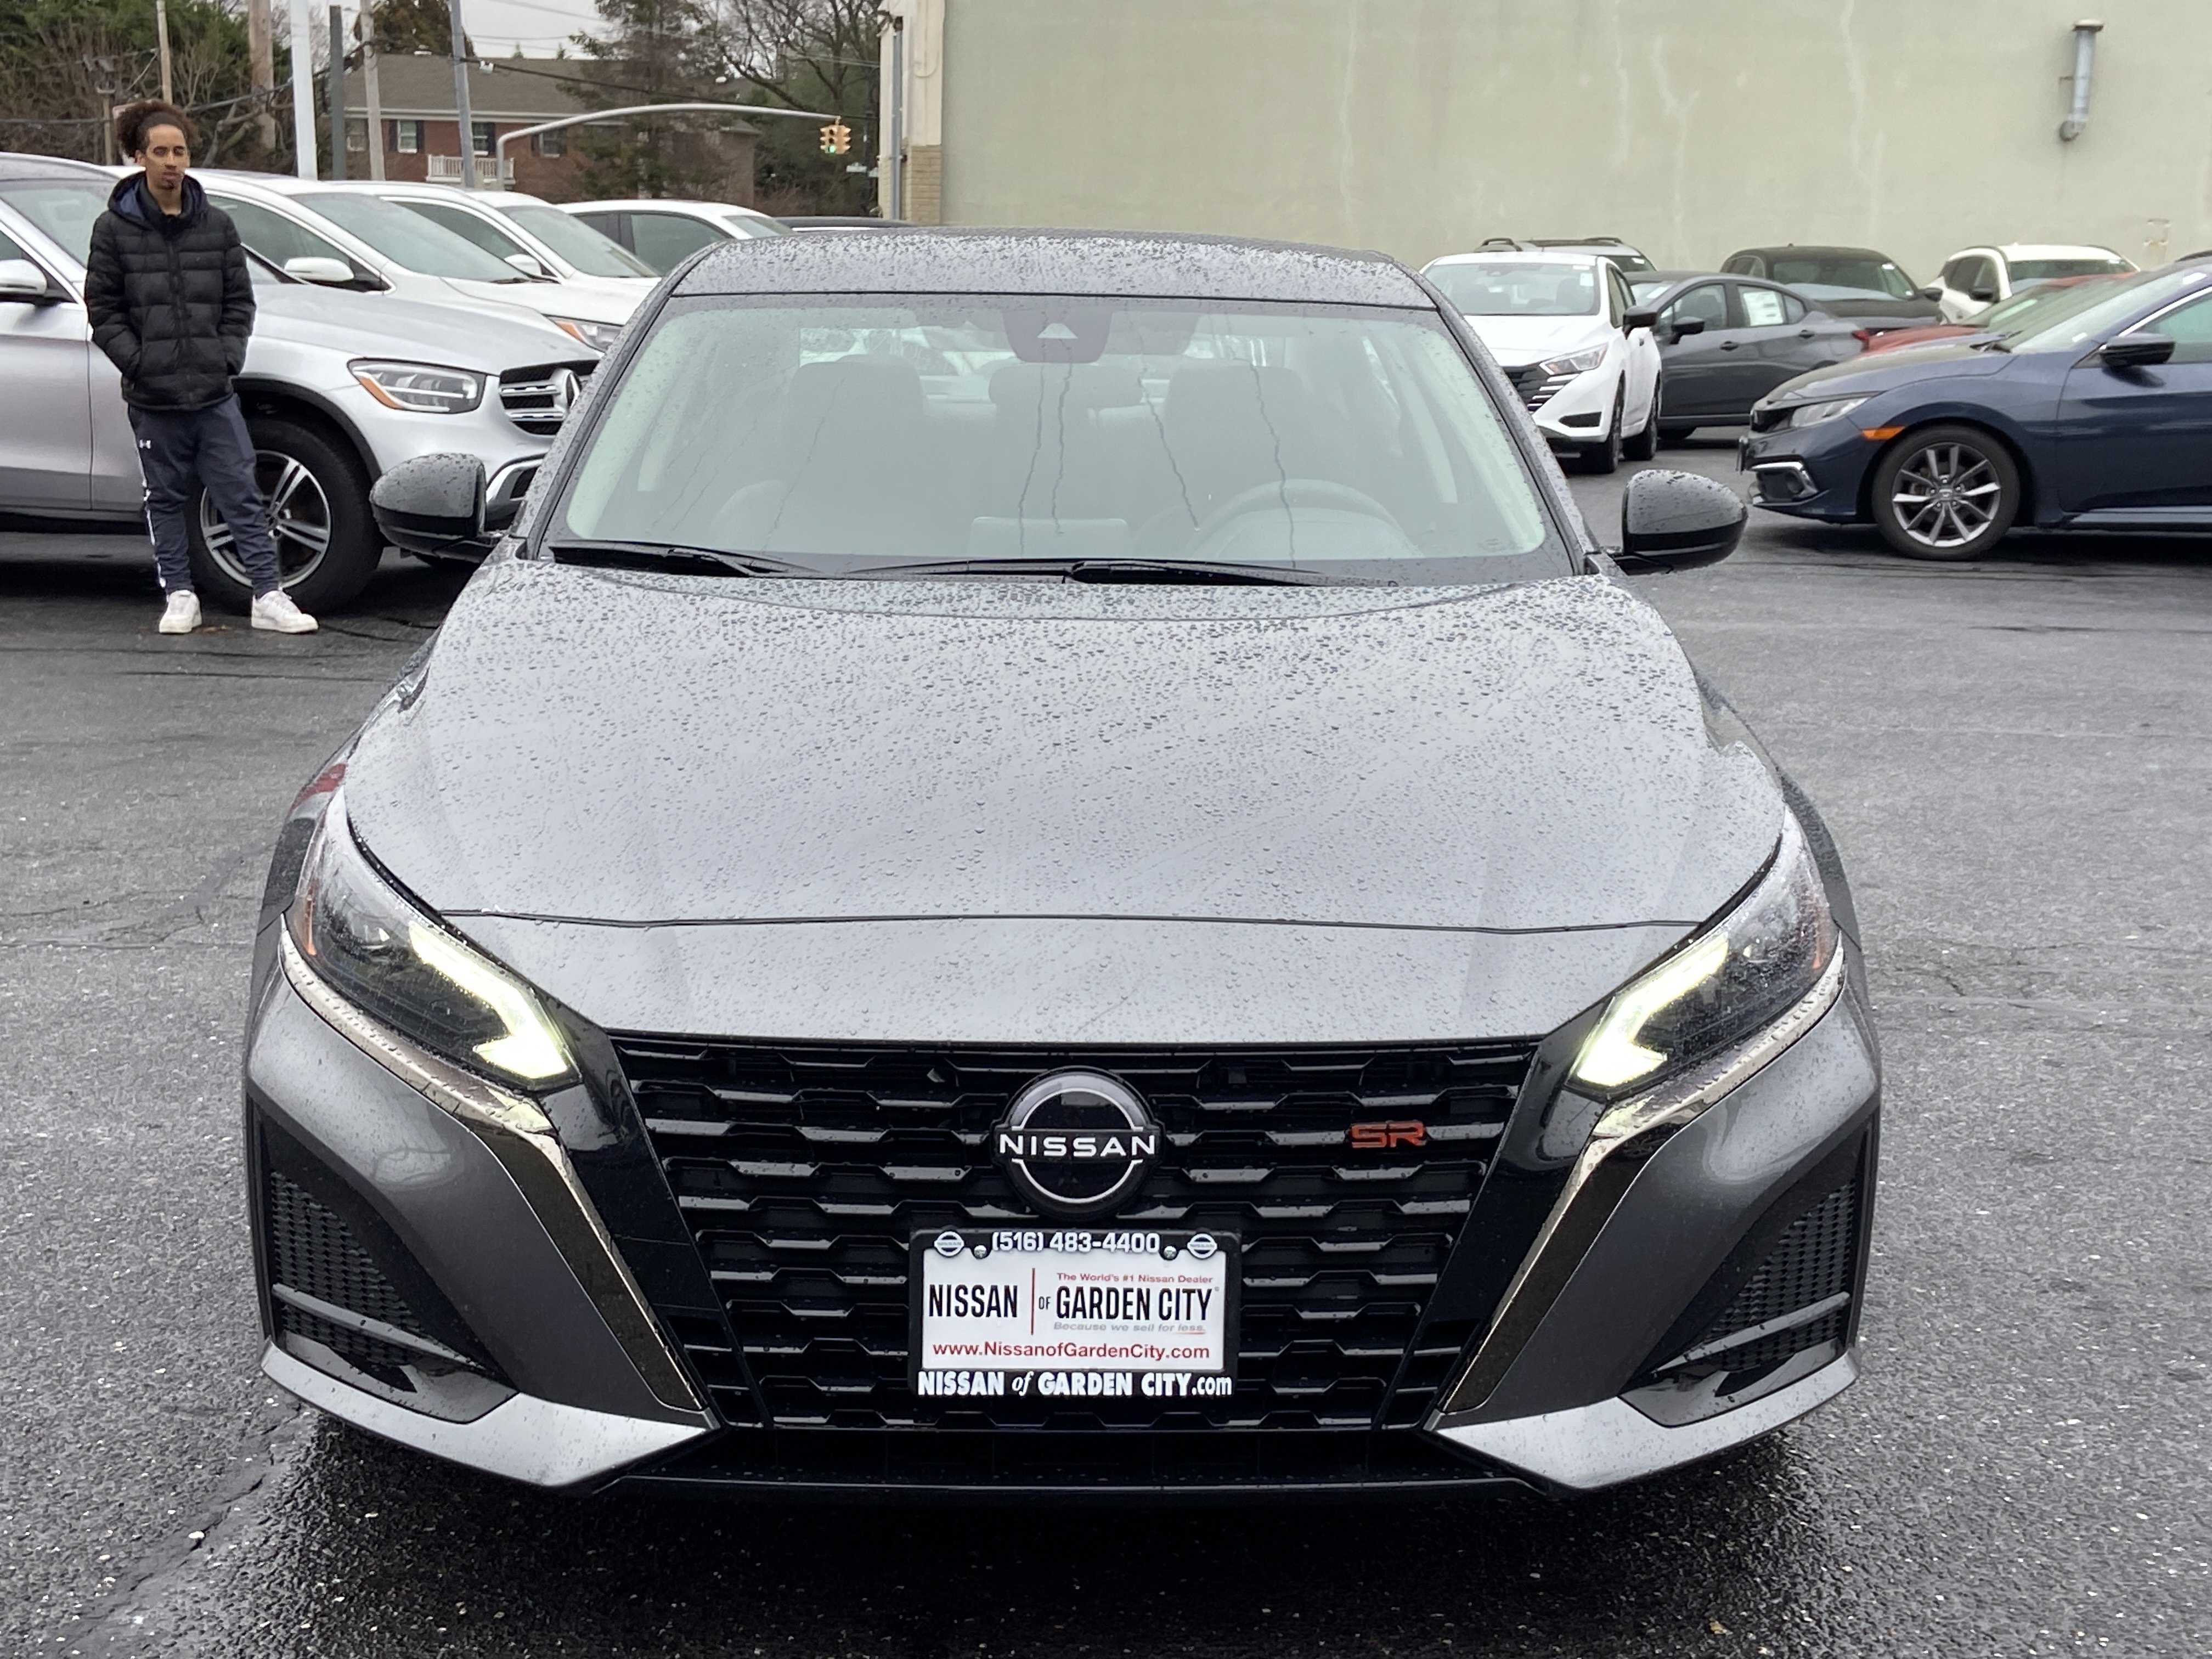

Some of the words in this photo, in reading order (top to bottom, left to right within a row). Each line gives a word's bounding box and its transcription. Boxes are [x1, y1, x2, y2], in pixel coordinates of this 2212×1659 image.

[1000, 1133, 1155, 1156] NISSAN
[1351, 1121, 1426, 1148] SR
[992, 1232, 1044, 1251] (516)
[1049, 1232, 1160, 1253] 483-4400
[1080, 1273, 1120, 1282] World's
[1138, 1274, 1174, 1283] Nissan
[1178, 1275, 1214, 1283] Dealer
[929, 1284, 1018, 1318] NISSAN
[1039, 1296, 1051, 1310] OF
[1057, 1286, 1150, 1321] GARDEN
[1159, 1288, 1212, 1321] CITY
[1054, 1322, 1107, 1330] Because
[933, 1341, 1210, 1361] www.NissanofGardenCity.com
[918, 1371, 1005, 1396] NISSAN
[1012, 1371, 1034, 1396] of
[1037, 1372, 1132, 1396] GARDEN
[1141, 1372, 1232, 1396] CITY.com
